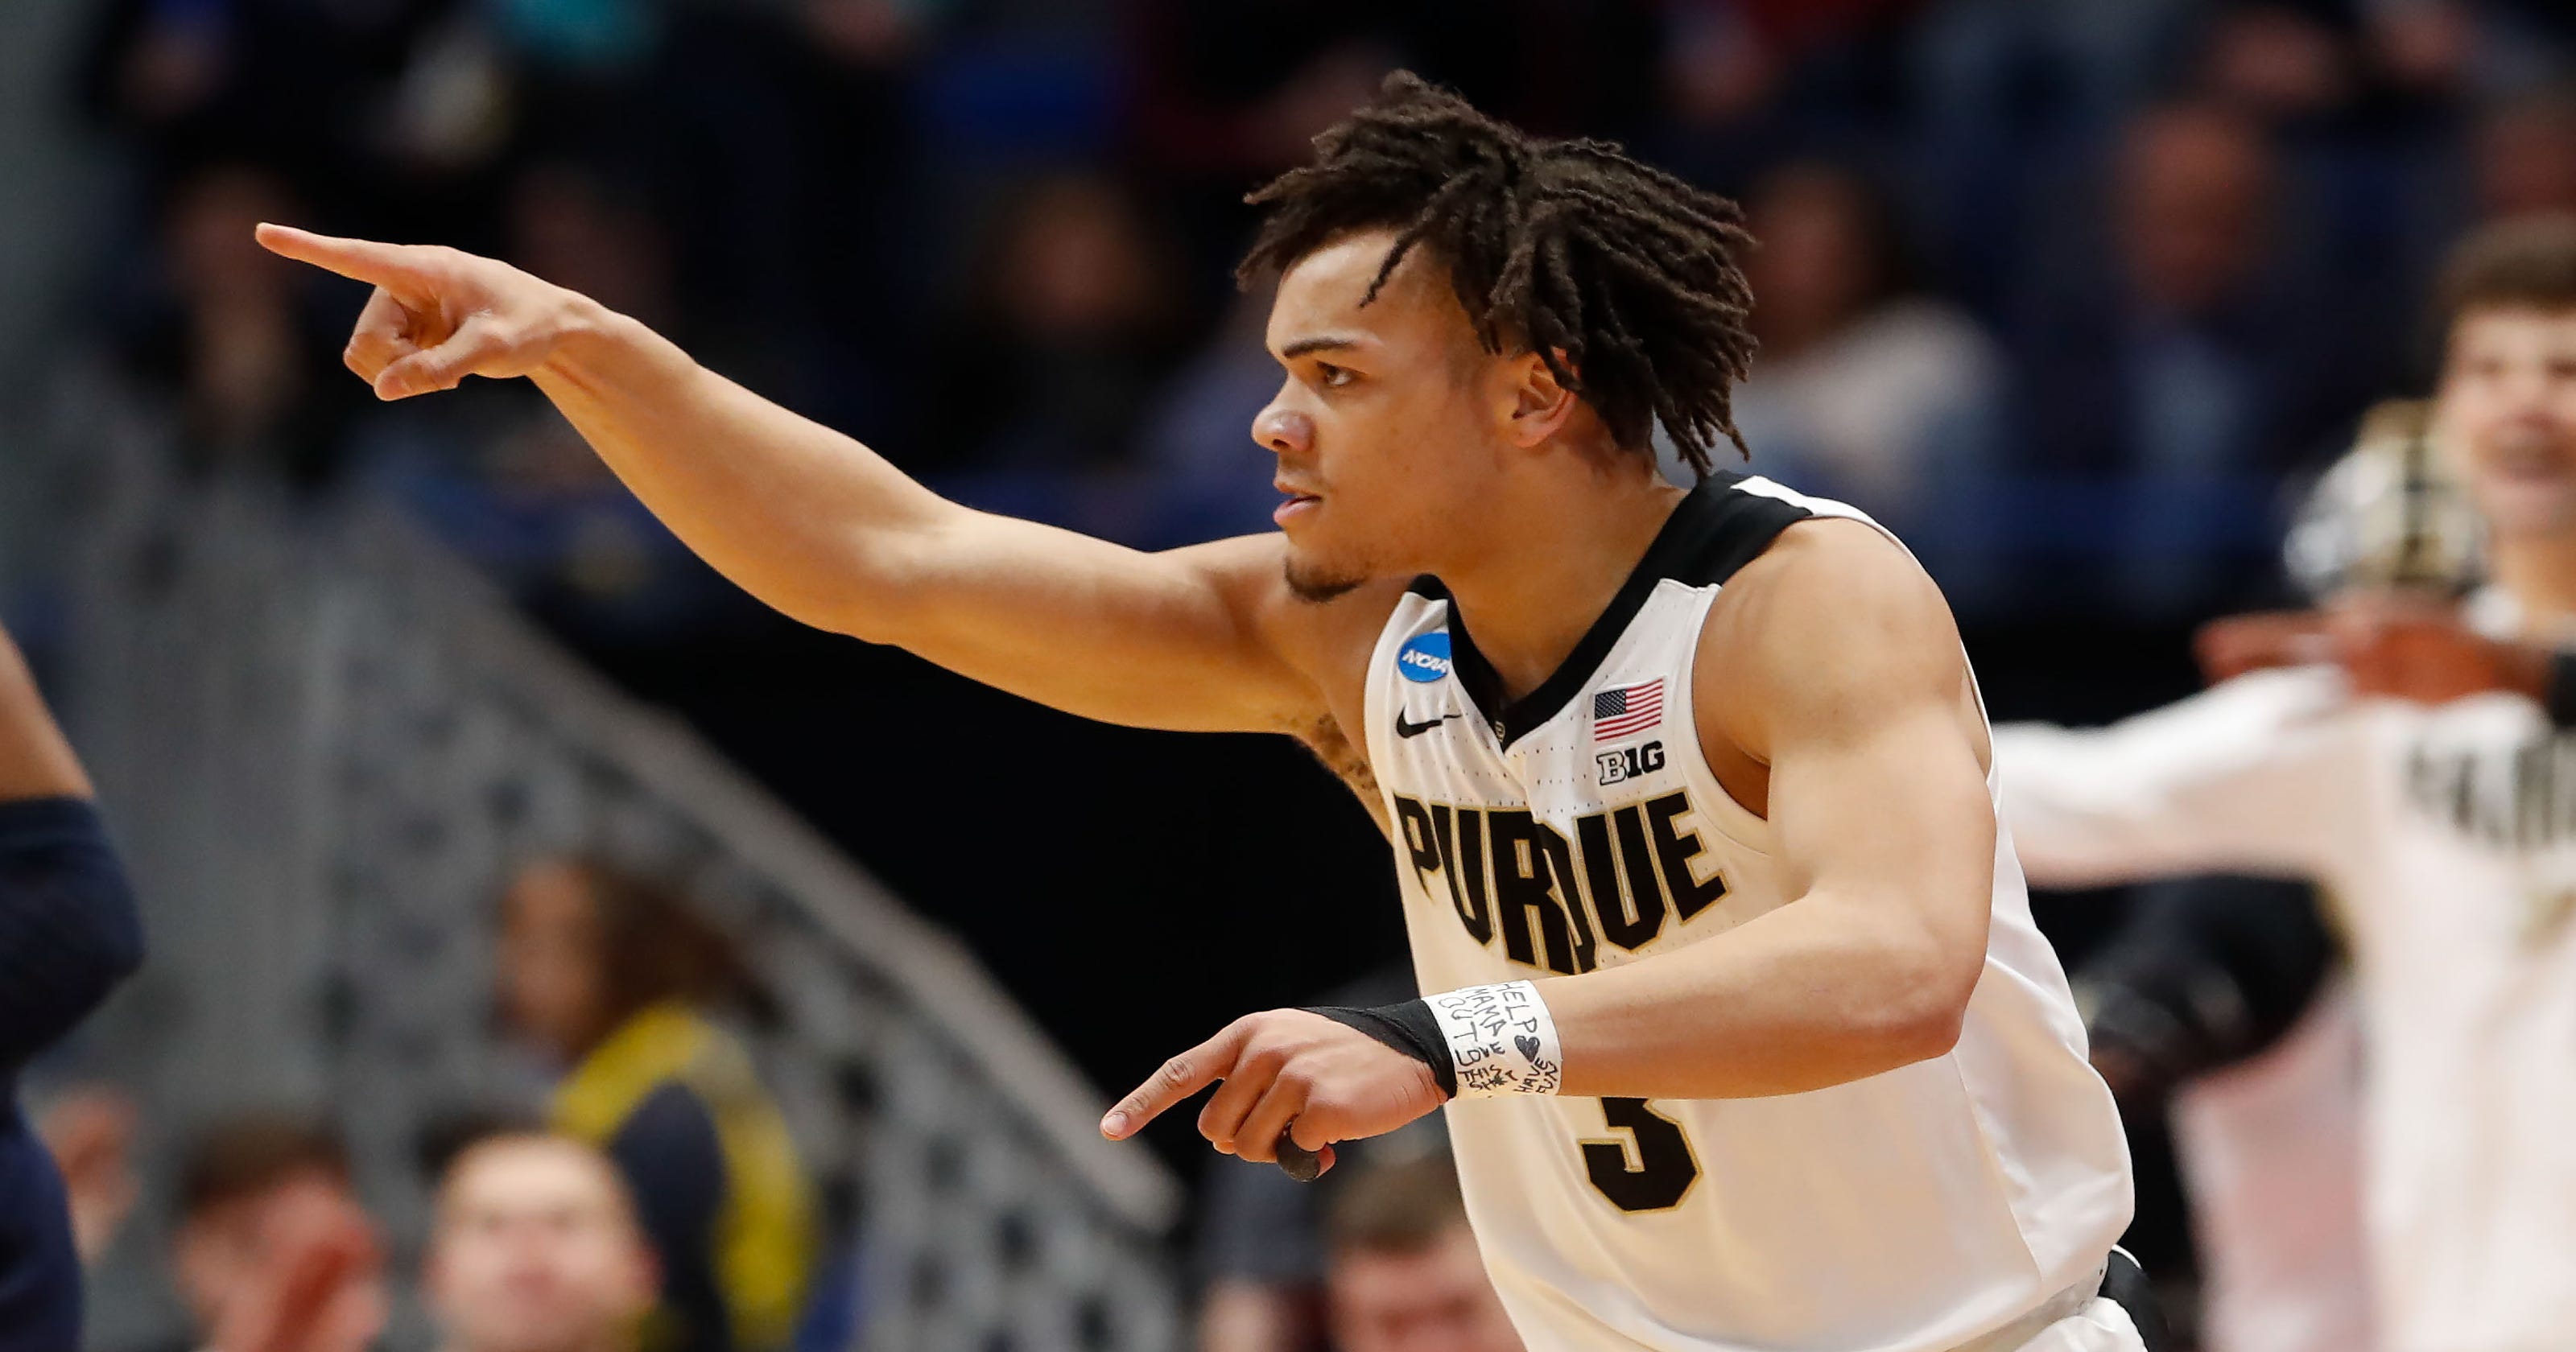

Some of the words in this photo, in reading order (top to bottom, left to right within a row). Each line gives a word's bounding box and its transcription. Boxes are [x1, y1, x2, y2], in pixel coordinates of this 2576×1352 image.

[1402, 649, 1450, 674] NCAA
[1438, 997, 1478, 1042] OUT
[1459, 988, 1507, 1037] MAMA
[1496, 983, 1538, 1033] HELP
[1578, 1096, 1703, 1216] 3
